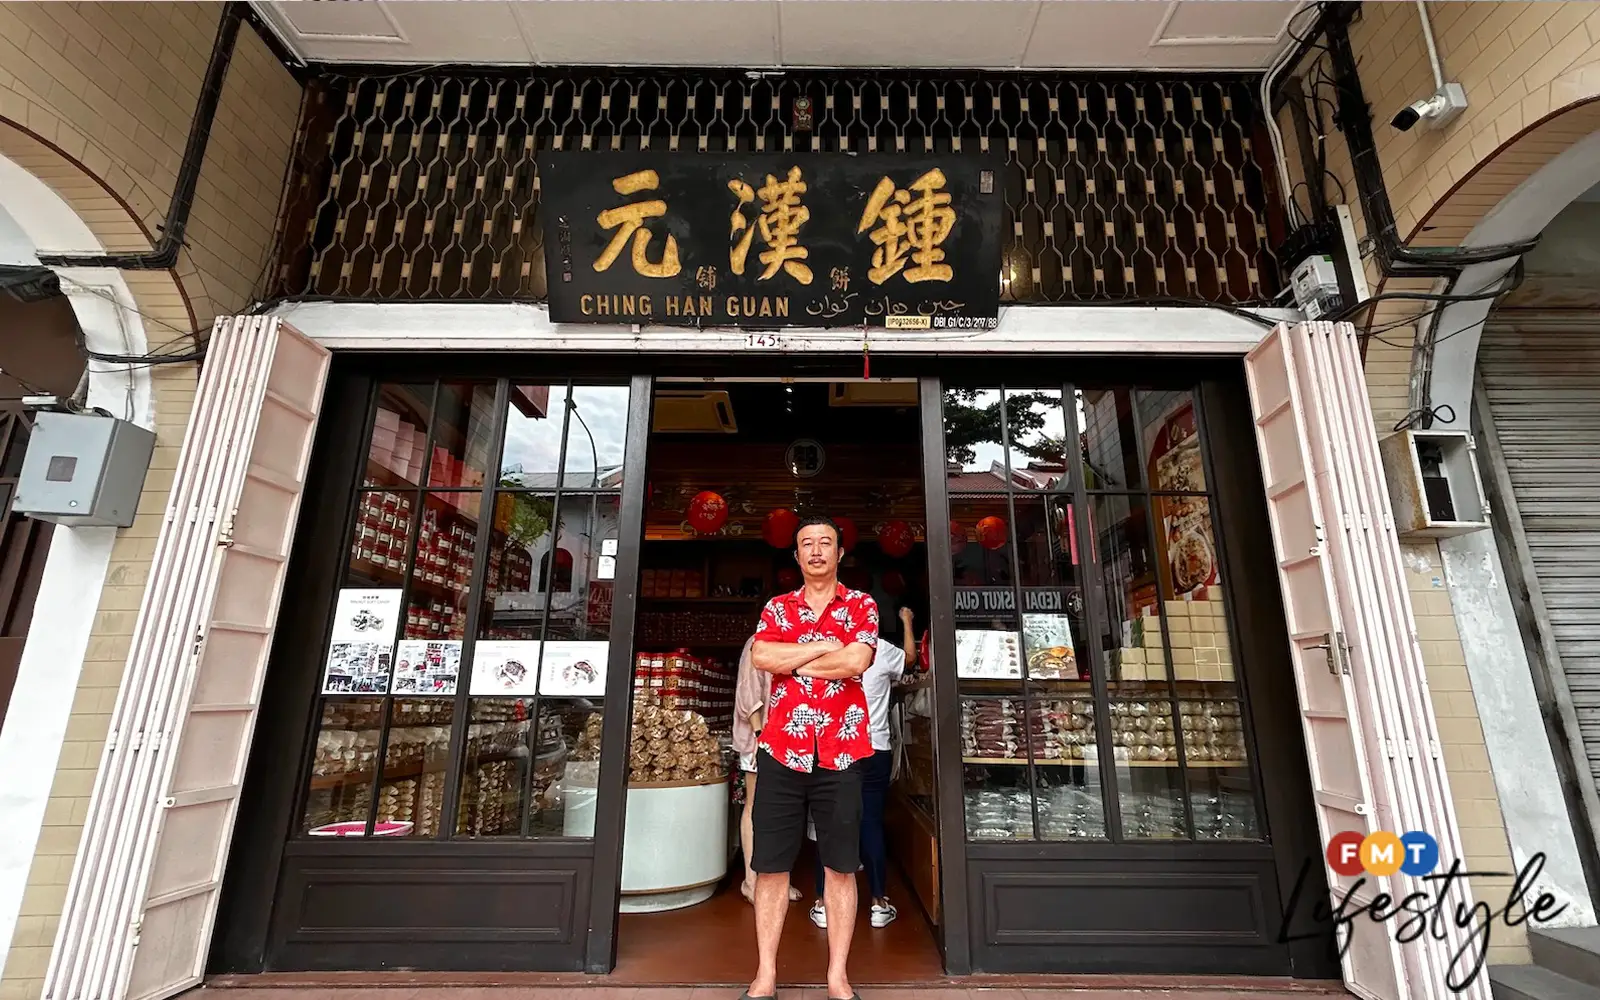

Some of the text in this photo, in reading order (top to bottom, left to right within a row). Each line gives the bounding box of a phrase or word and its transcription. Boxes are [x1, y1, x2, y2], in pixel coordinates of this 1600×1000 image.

[580, 294, 789, 317] CHING HAN GUAN
[748, 334, 776, 347] 145
